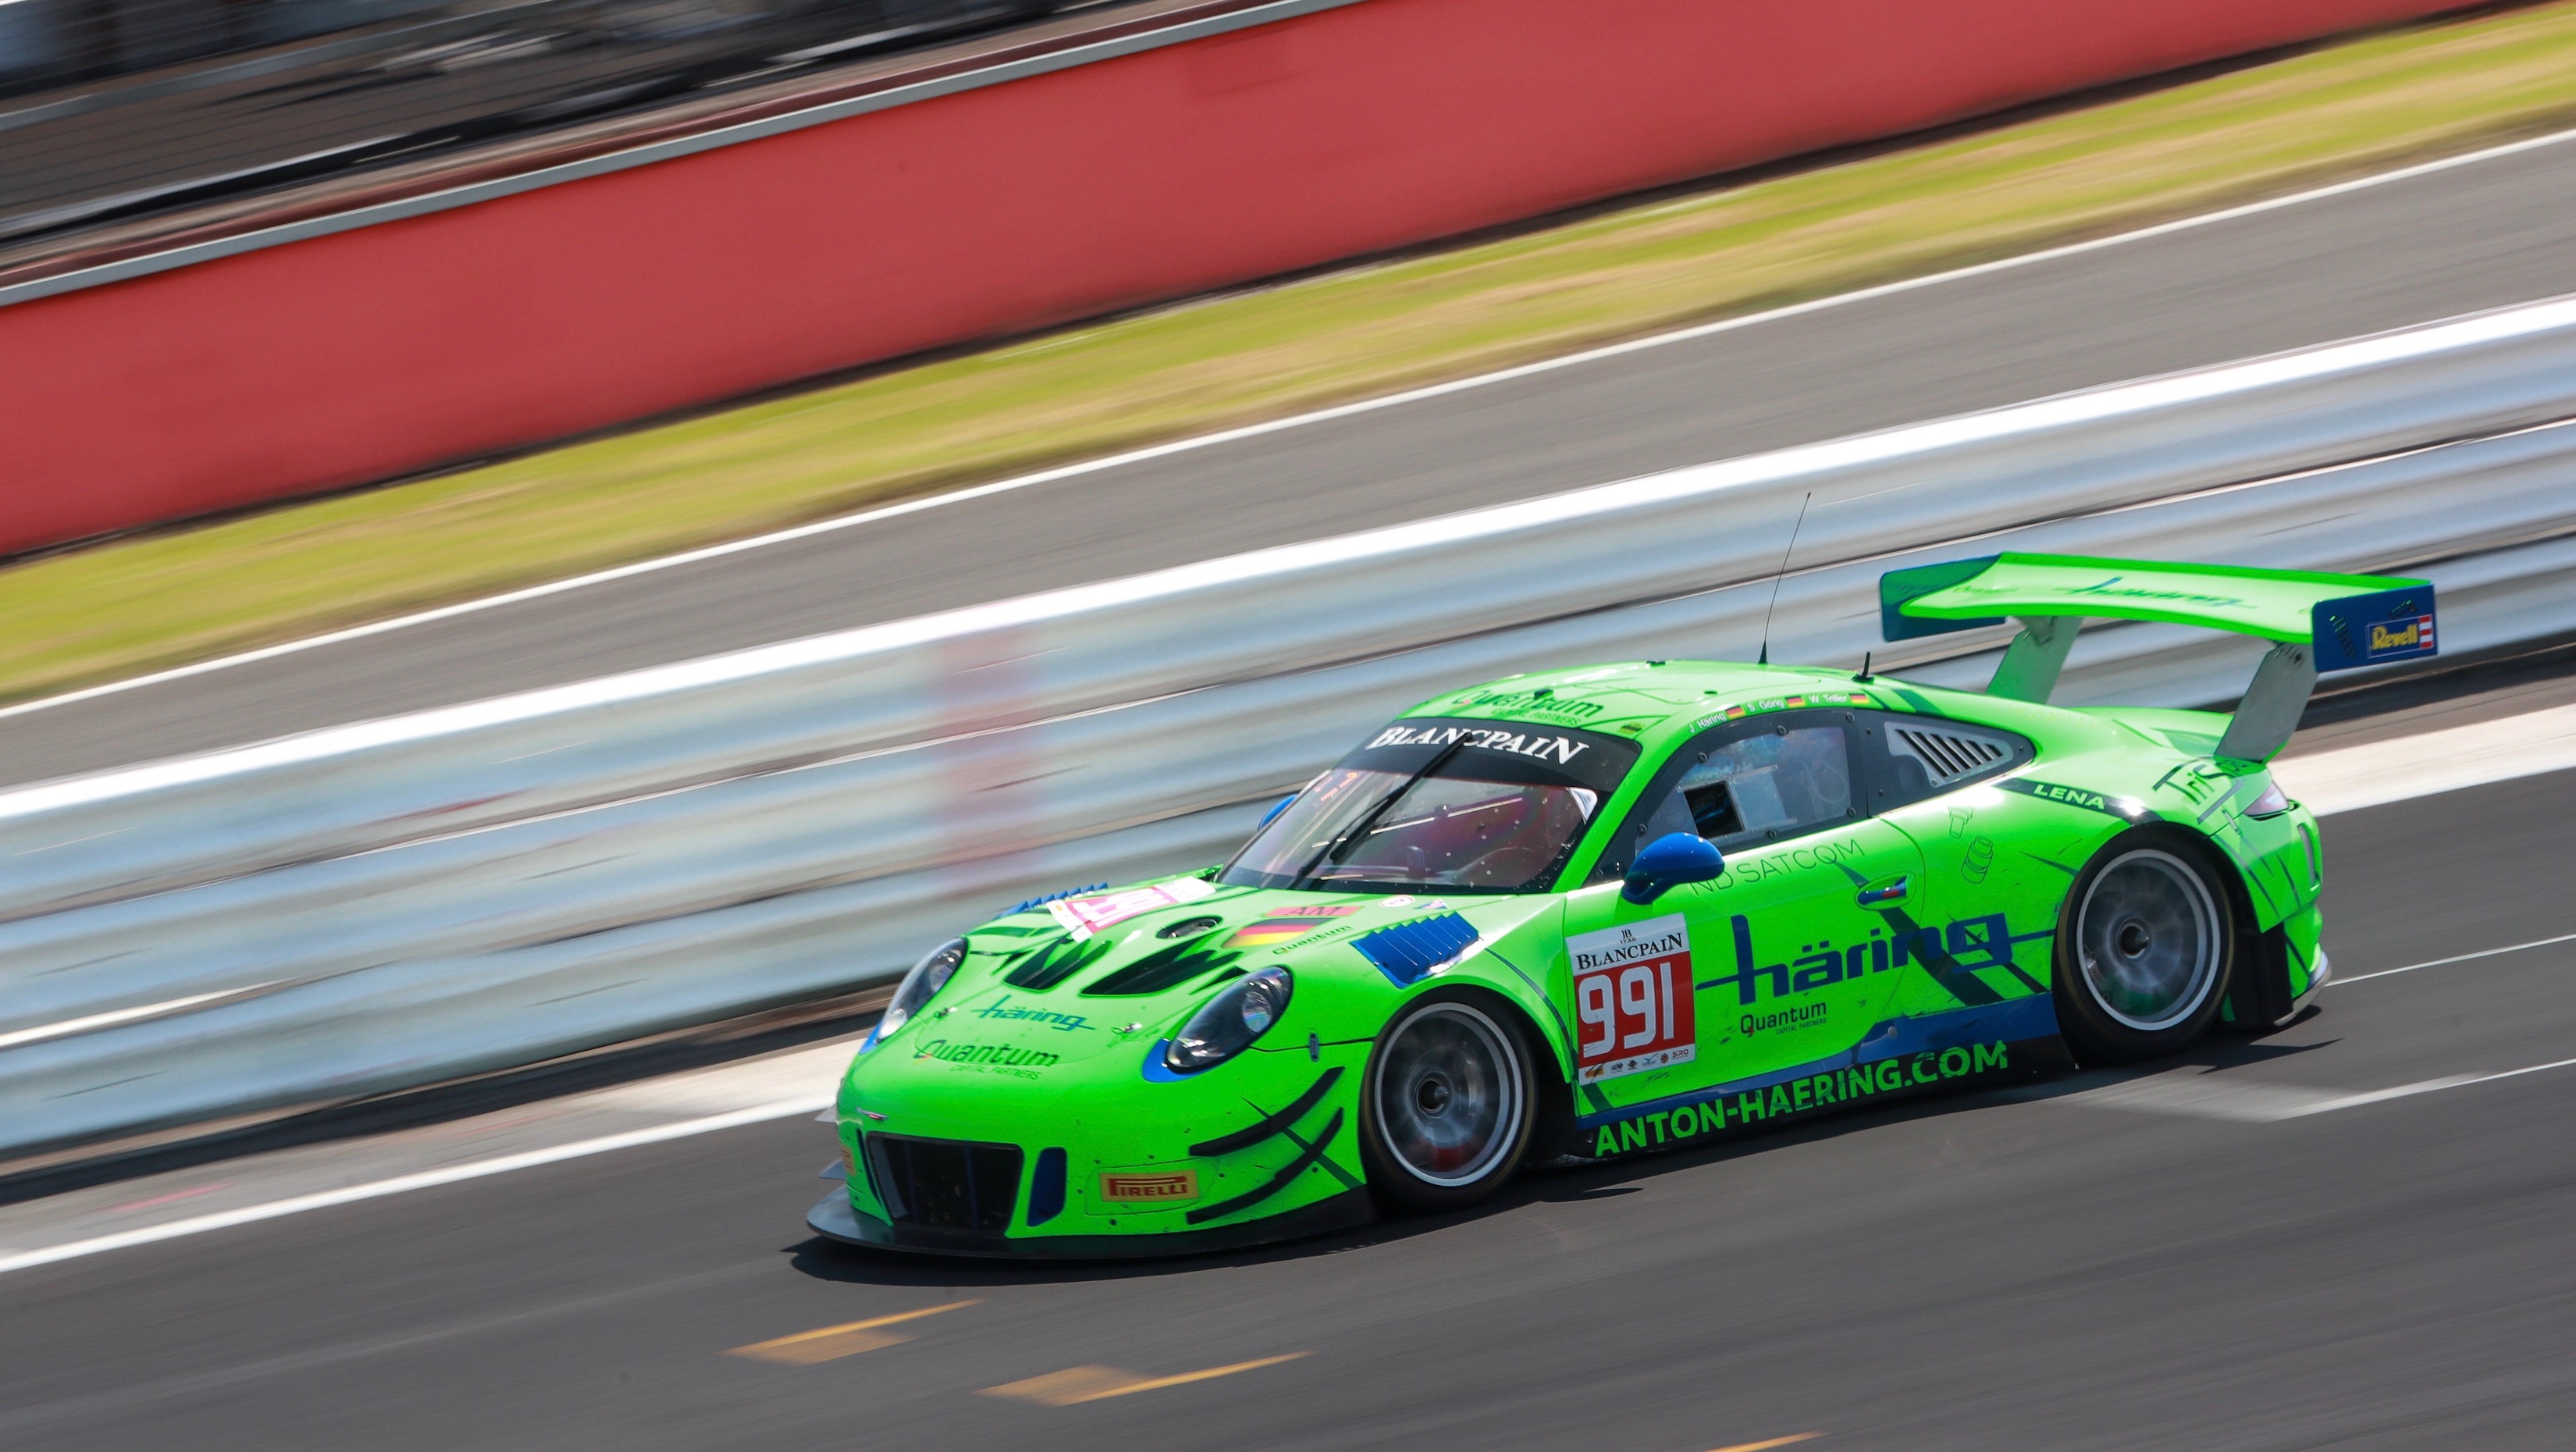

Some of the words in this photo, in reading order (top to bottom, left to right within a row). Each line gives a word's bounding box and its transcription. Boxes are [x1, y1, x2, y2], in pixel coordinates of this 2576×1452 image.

[2370, 623, 2419, 650] Revell
[1698, 711, 1727, 729] Häring
[1364, 725, 1590, 765] BLANCPAIN
[2033, 784, 2105, 810] LENA
[1736, 838, 1866, 883] SATCOM
[1272, 925, 1352, 956] Quantum
[1575, 932, 1683, 971] BLANCPAIN
[1695, 913, 2055, 1006] häring
[970, 994, 1096, 1031] häring
[1578, 961, 1674, 1059] 991
[1740, 1002, 1827, 1038] Quantum
[913, 1039, 1060, 1067] Quantum
[1672, 1048, 1690, 1058] SRO
[1594, 1039, 2008, 1158] ANTON-HAERING.COM
[1108, 1176, 1188, 1197] PIRELLI
